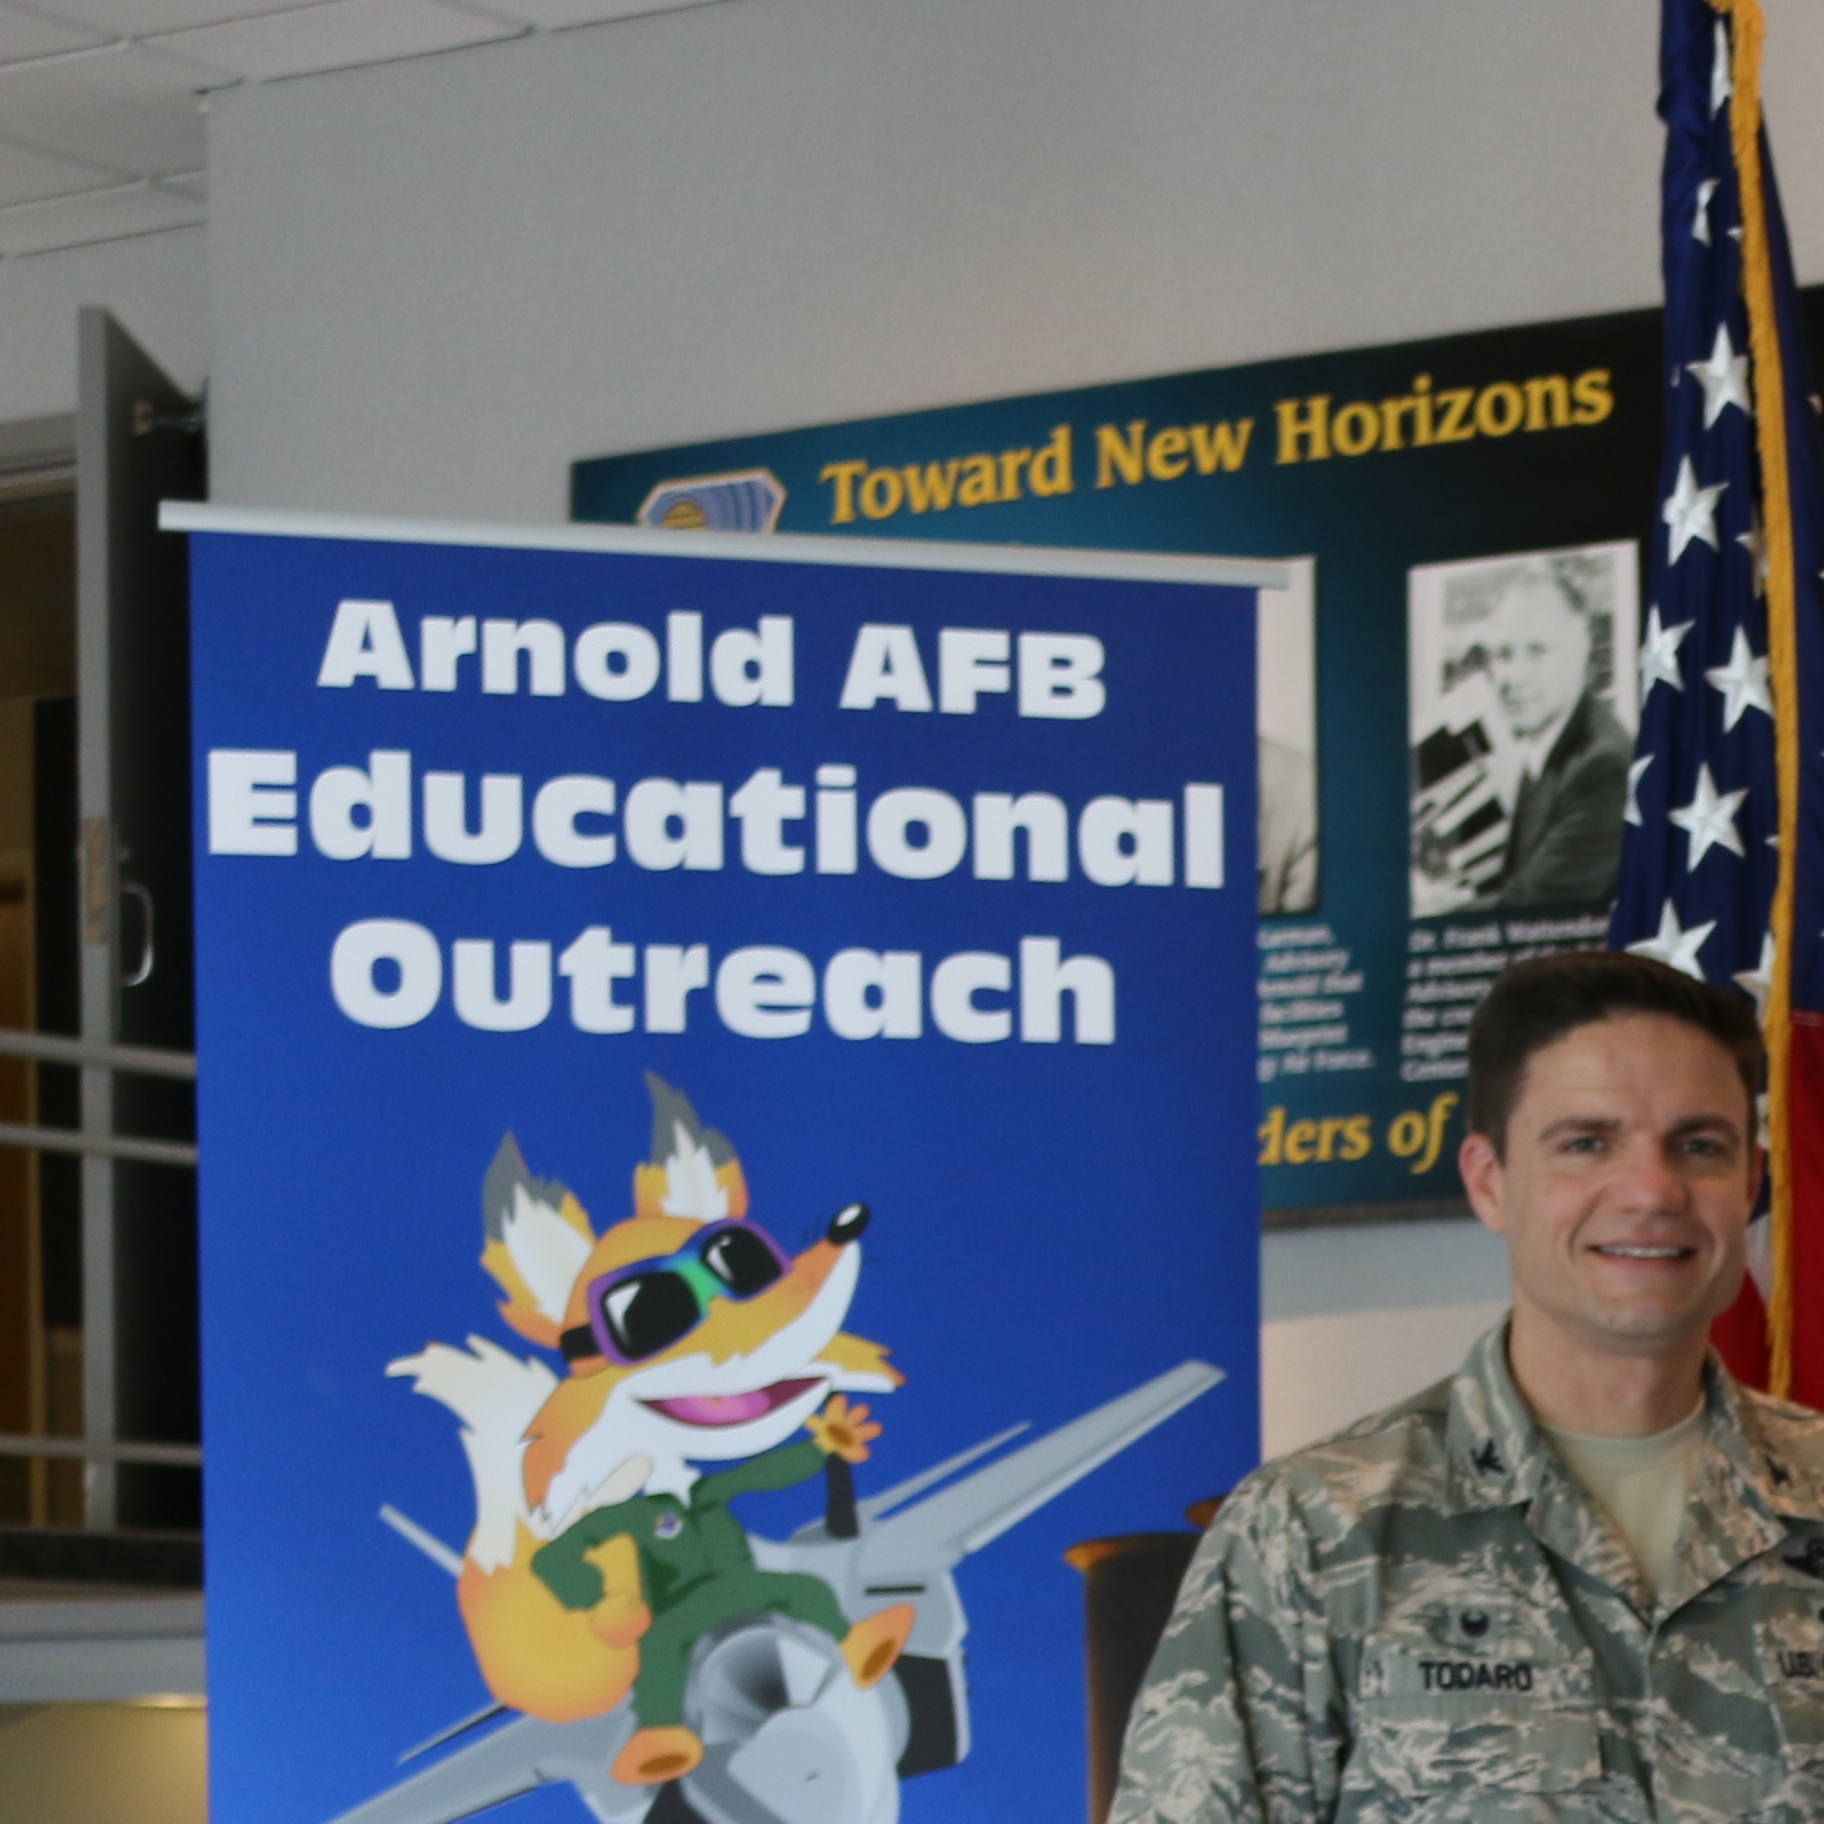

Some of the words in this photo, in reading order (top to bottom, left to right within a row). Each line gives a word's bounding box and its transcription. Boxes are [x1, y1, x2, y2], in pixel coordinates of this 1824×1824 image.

[820, 425, 1074, 524] Toward
[1096, 417, 1254, 489] New
[1274, 368, 1614, 465] Horizons
[317, 598, 795, 707] Arnold
[838, 622, 1108, 720] AFB
[207, 748, 1226, 889] Educational
[330, 918, 1116, 1045] Outreach
[1387, 1092, 1459, 1175] of
[1418, 1660, 1533, 1692] TODARO
